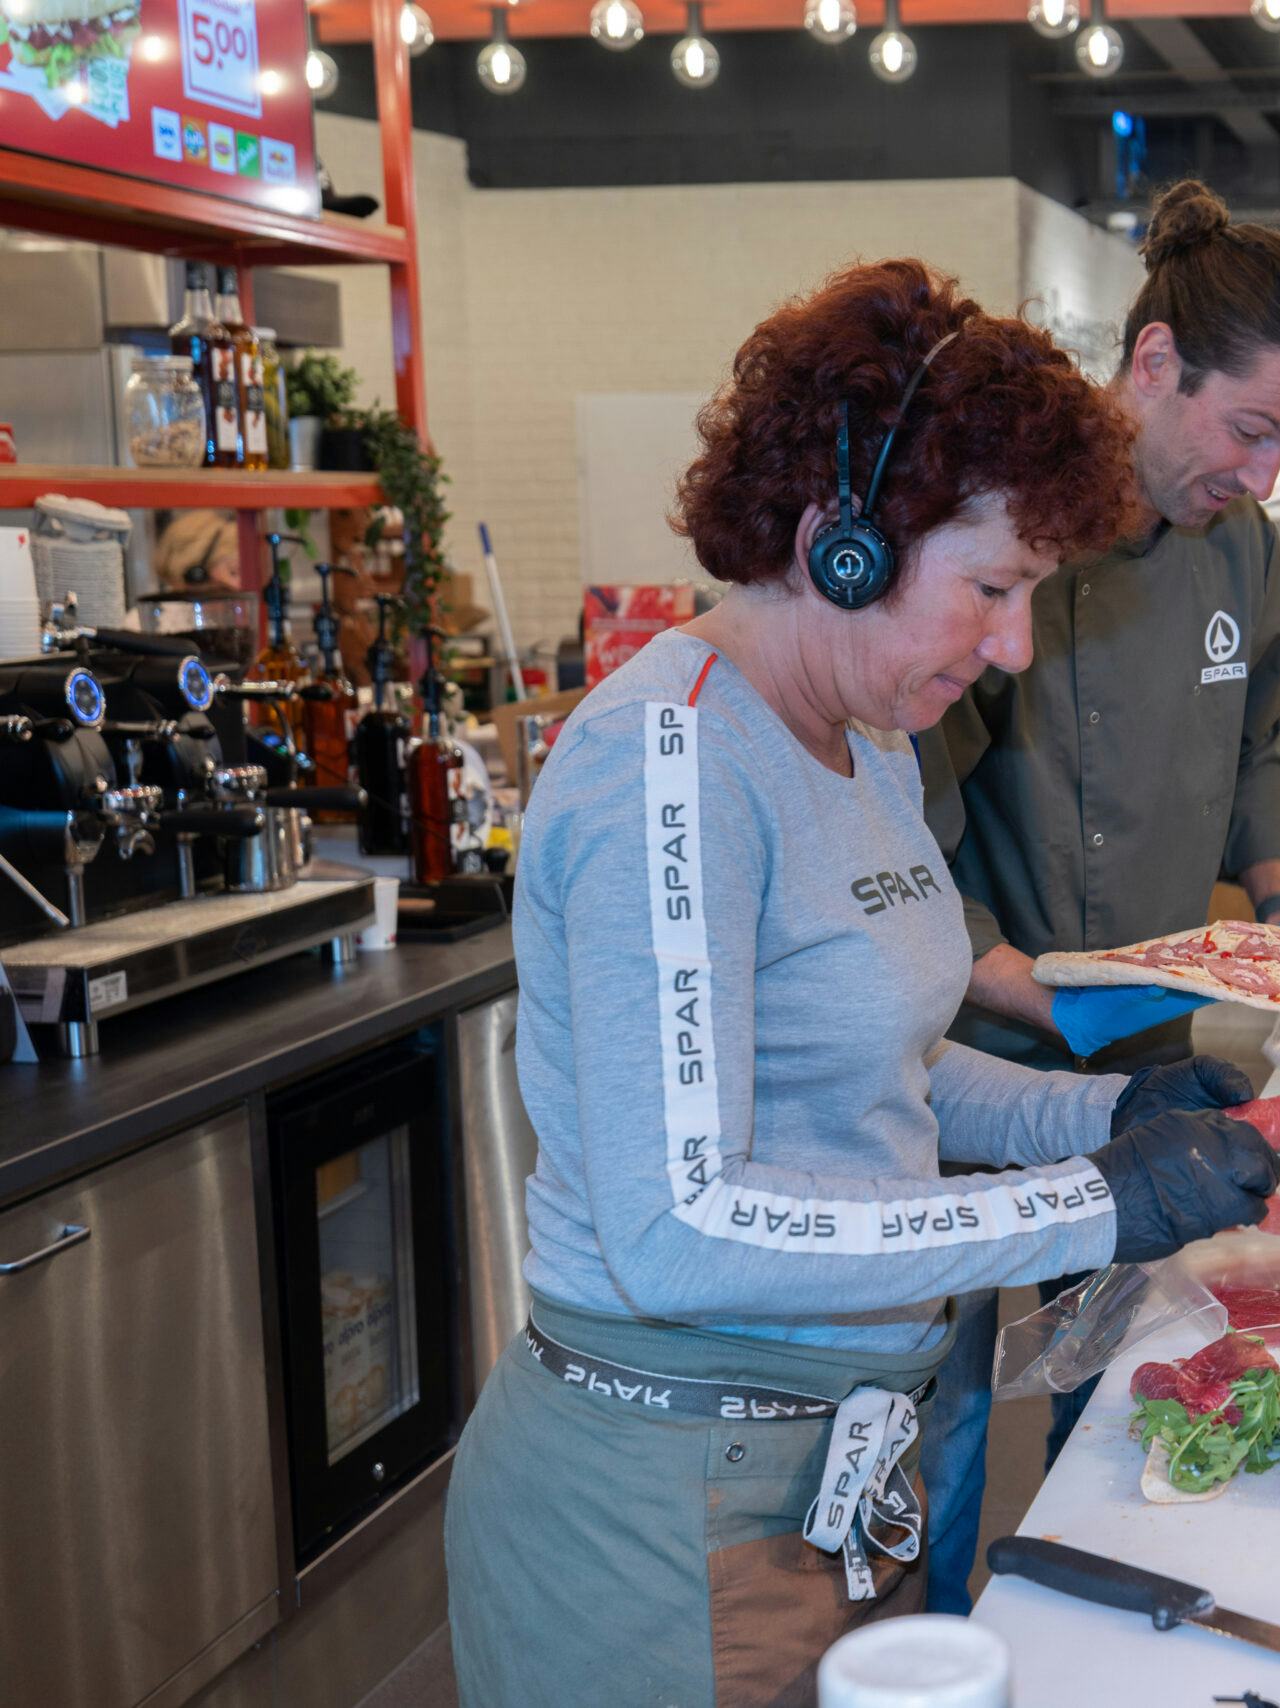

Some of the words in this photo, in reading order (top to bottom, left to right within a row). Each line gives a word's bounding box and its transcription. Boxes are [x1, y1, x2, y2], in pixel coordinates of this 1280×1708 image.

[1203, 665, 1244, 681] SPAR
[661, 803, 692, 921] SPAR
[851, 864, 942, 916] SPAR
[674, 968, 704, 1085] SPAR
[684, 1135, 709, 1206] AR
[731, 1199, 836, 1239] SPAR
[881, 1206, 980, 1239] SPAR
[1015, 1178, 1110, 1219] SPAR
[828, 1421, 873, 1530] SPAR
